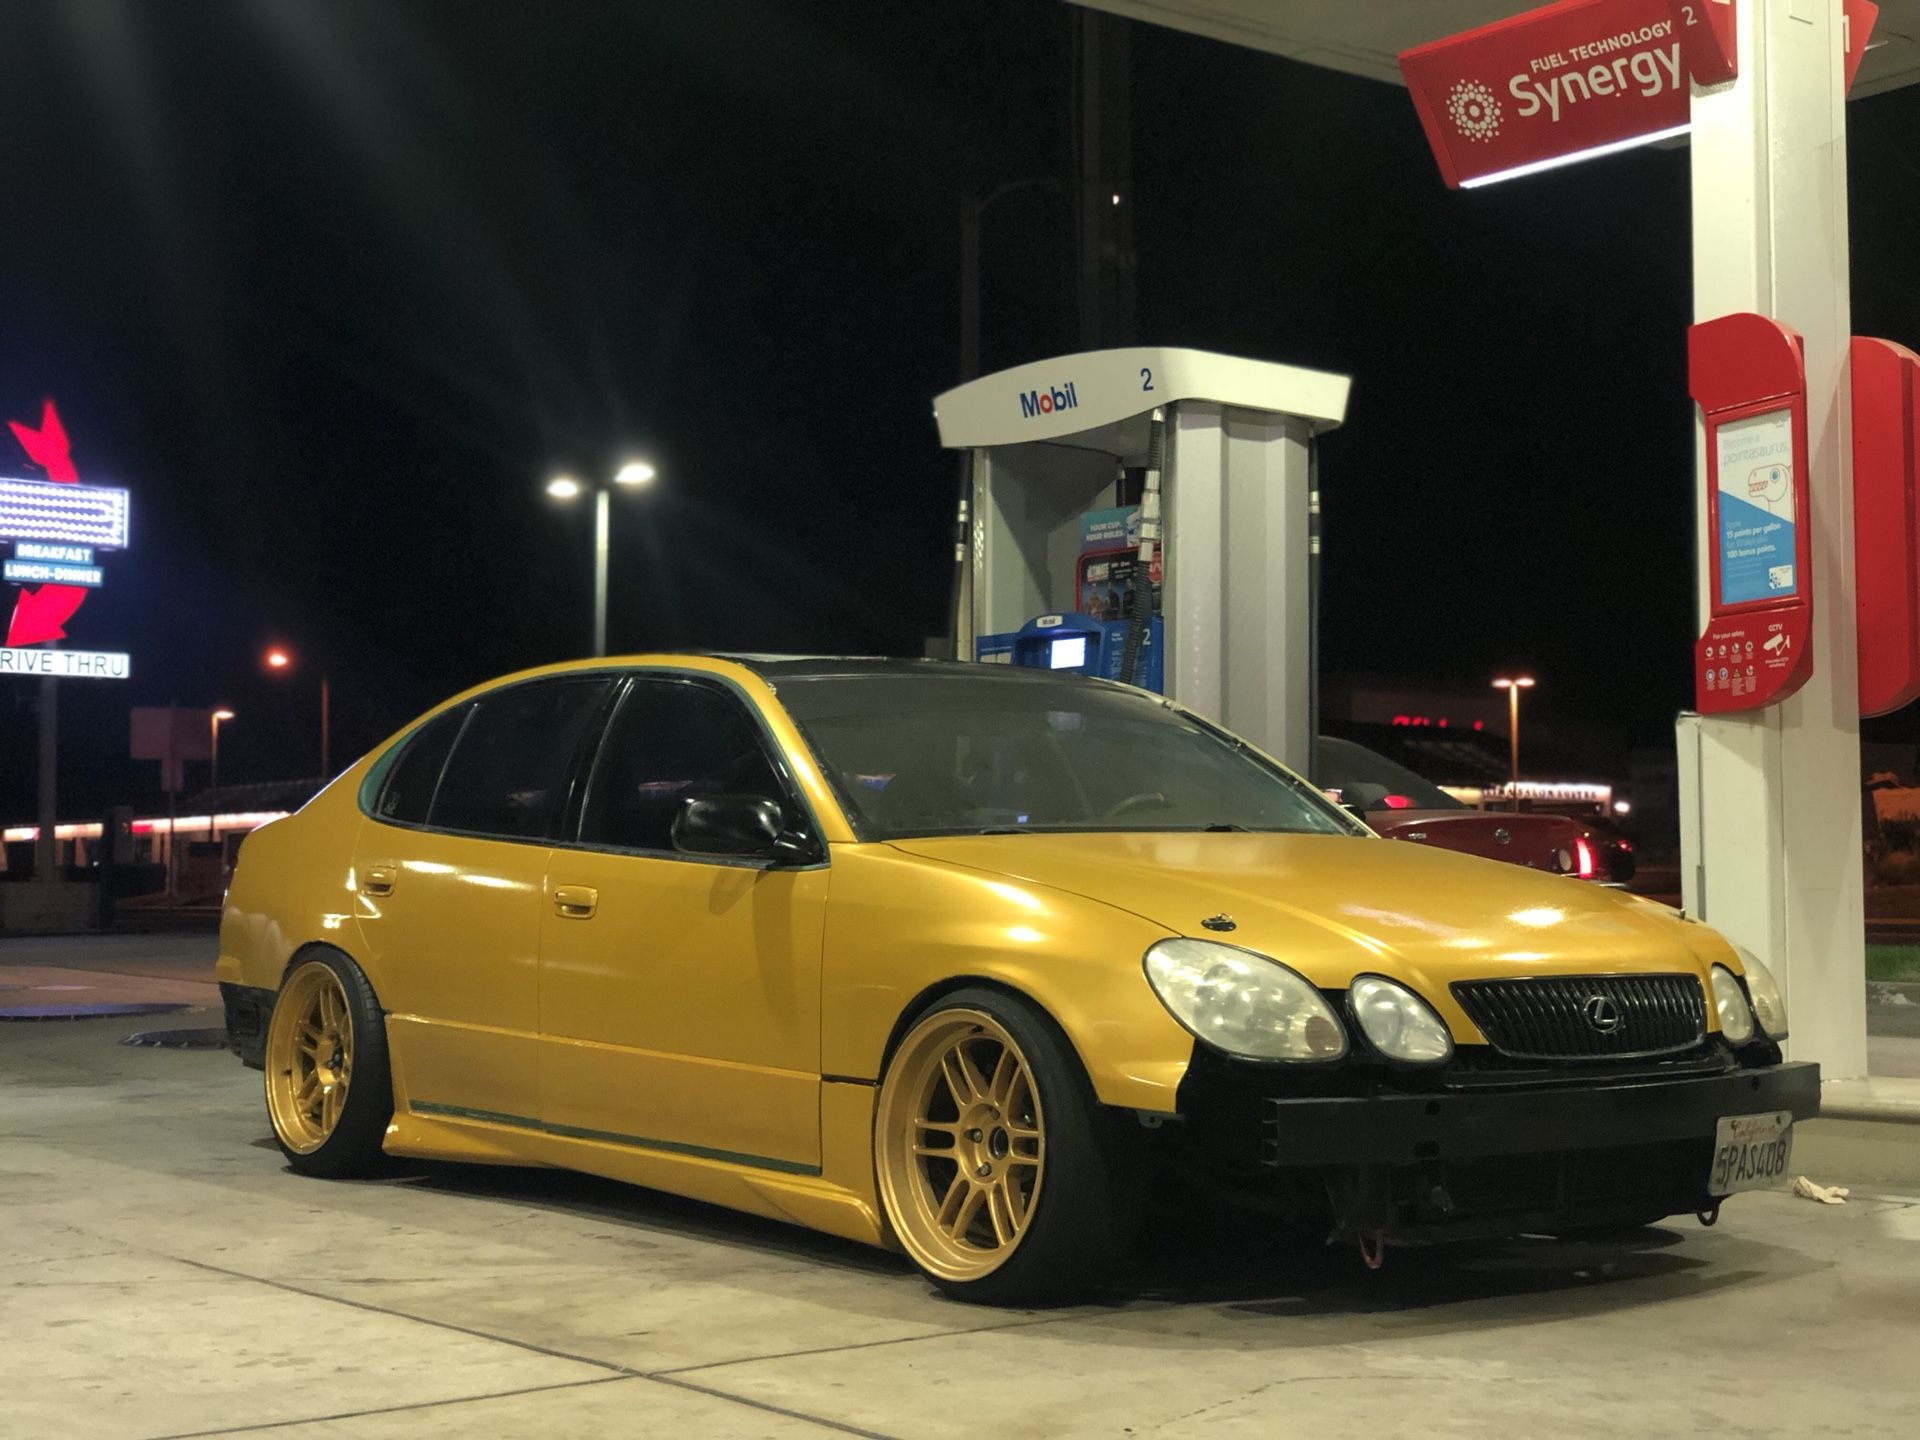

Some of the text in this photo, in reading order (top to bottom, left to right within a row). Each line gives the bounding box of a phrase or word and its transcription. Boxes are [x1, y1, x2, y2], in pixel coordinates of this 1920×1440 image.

[1681, 6, 1697, 26] 2
[1530, 20, 1673, 74] FUEL TECHNOLOGY
[1509, 43, 1680, 122] Synergy
[1140, 367, 1154, 391] 2
[1019, 382, 1078, 418] Mobil
[17, 543, 92, 561] BREAKFAST
[4, 564, 102, 583] LUNCH-DINNER
[1142, 628, 1151, 645] 2
[1768, 623, 1783, 632] CCTV
[63, 653, 124, 676] THRU
[1716, 1140, 1787, 1189] 5PAS408
